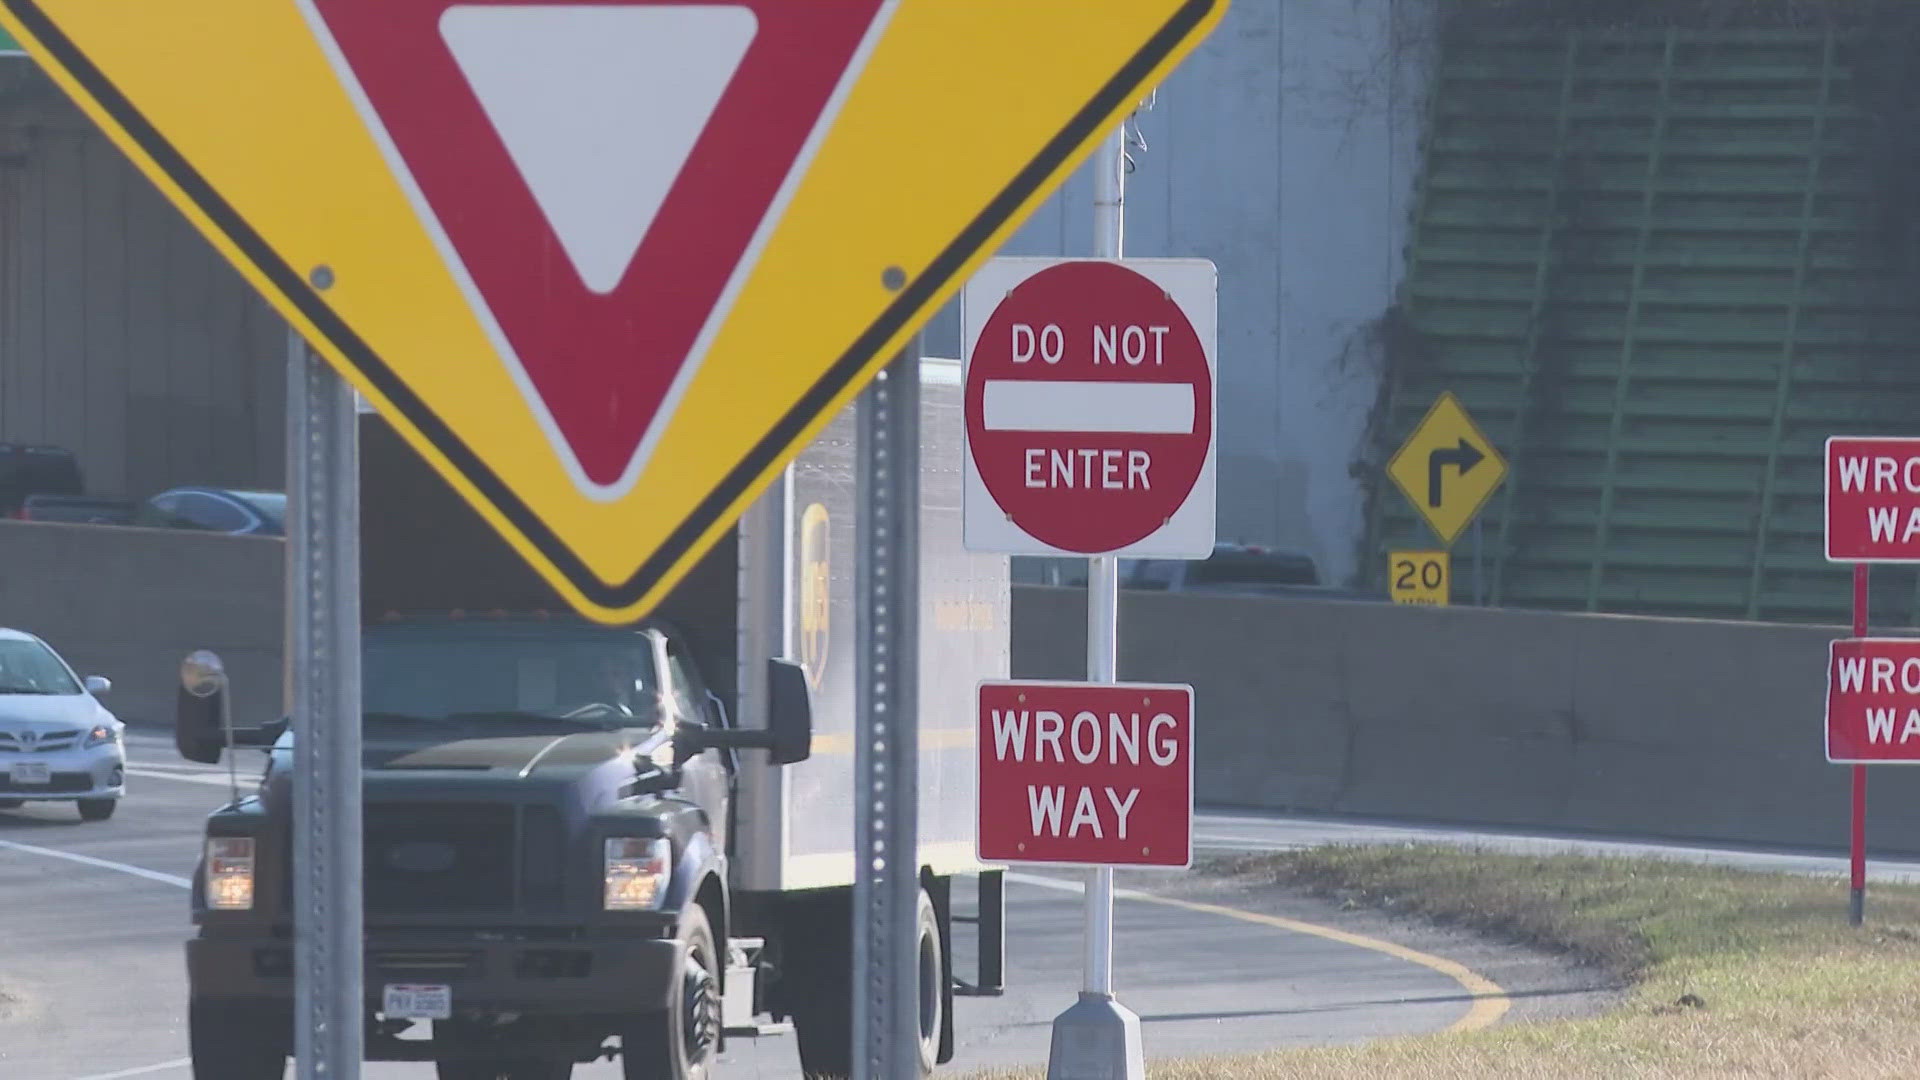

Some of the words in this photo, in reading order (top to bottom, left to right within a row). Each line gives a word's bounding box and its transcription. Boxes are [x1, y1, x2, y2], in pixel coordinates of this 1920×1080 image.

[1012, 324, 1064, 364] DO
[1093, 325, 1170, 365] NOT
[1025, 448, 1151, 490] ENTER
[1396, 560, 1442, 590] 20
[1838, 657, 1920, 694] WRO
[992, 709, 1179, 767] WRONG
[1027, 785, 1140, 839] WAY
